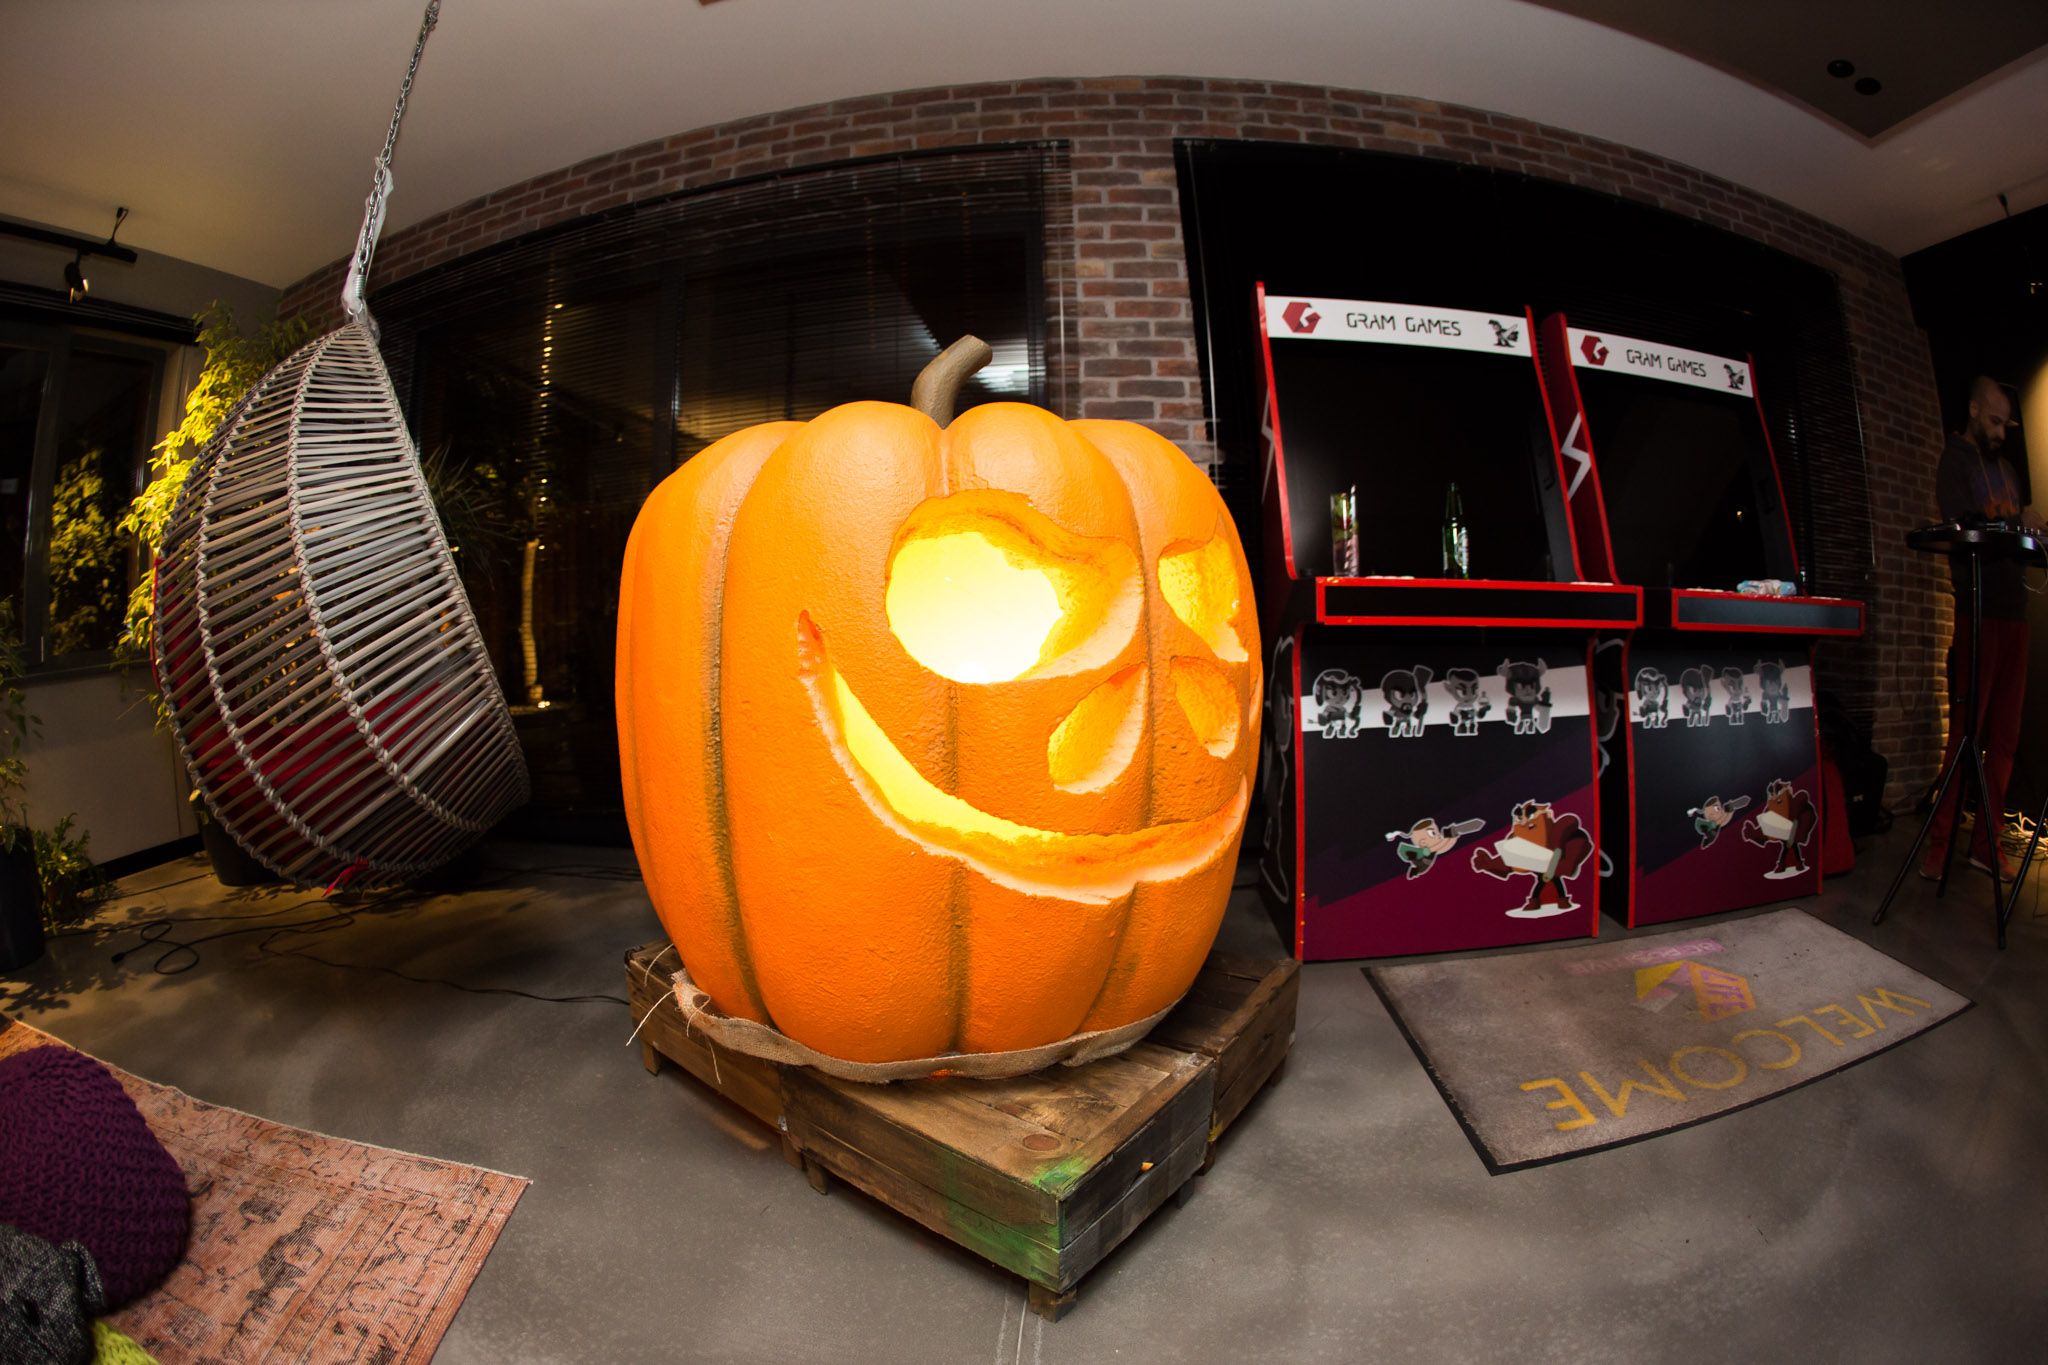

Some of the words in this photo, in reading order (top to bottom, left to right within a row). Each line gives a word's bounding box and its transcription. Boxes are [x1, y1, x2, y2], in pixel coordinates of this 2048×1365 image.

[1345, 312, 1396, 331] GRAM
[1404, 317, 1462, 336] GAMES
[1626, 349, 1662, 368] GRAM
[1667, 357, 1707, 377] GAMES
[1519, 986, 1932, 1132] WELCOME
